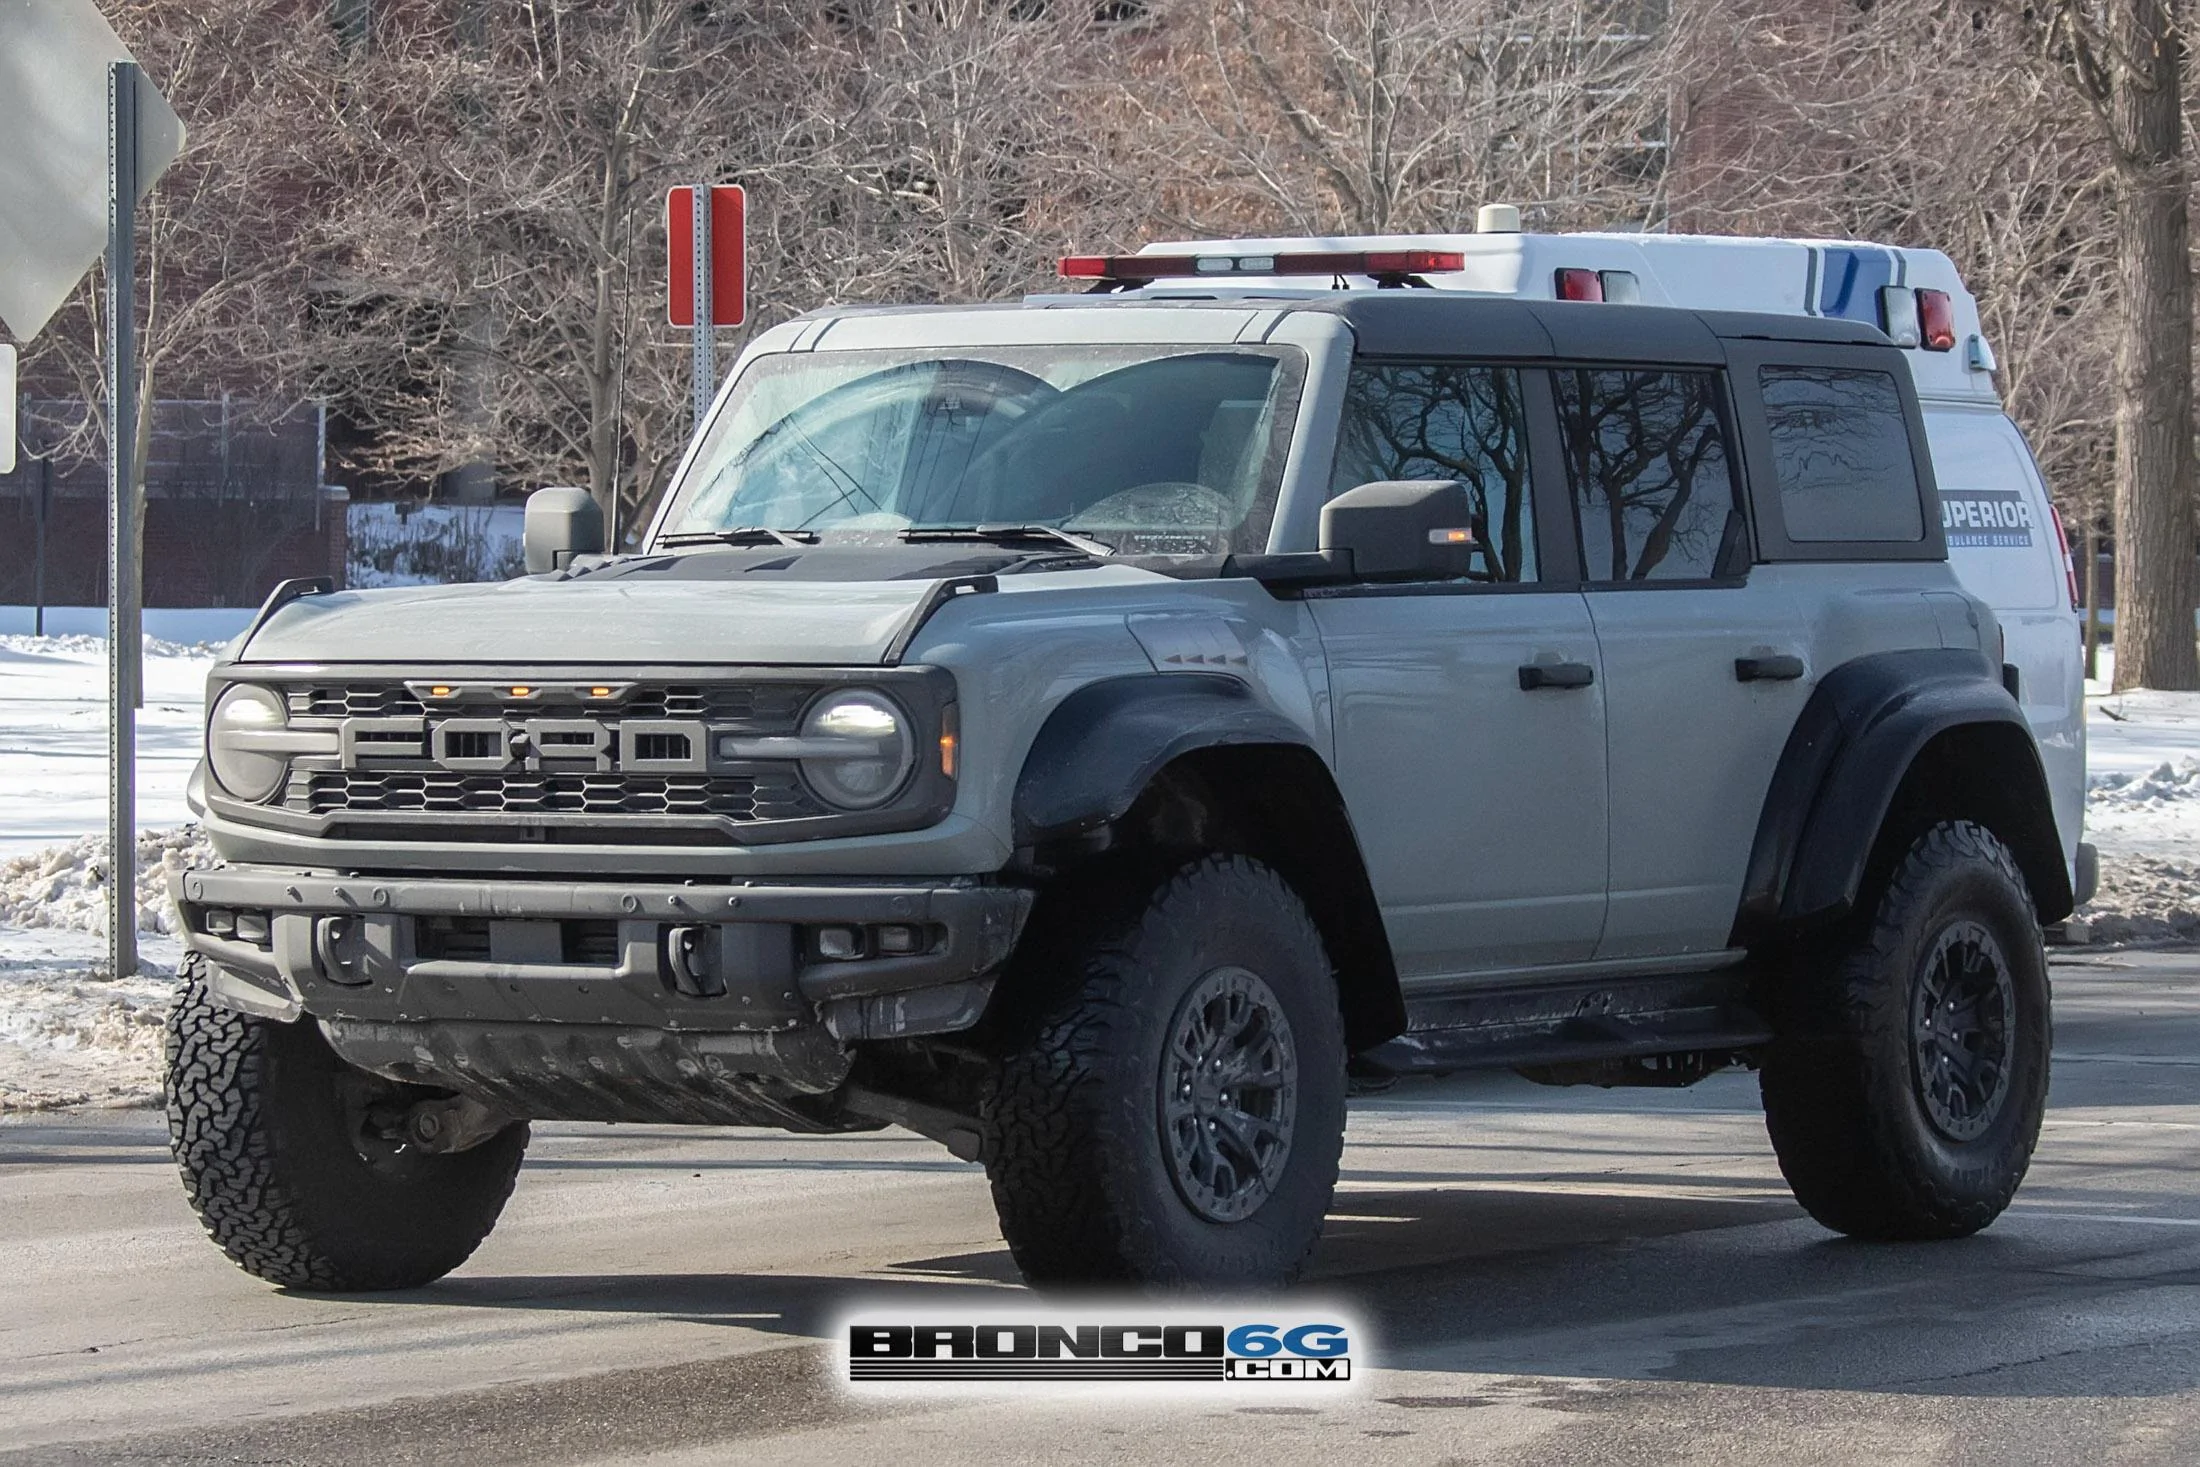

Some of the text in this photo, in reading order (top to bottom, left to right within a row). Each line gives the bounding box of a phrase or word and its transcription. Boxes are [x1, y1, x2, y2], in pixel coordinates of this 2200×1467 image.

[1942, 500, 2034, 528] UPERIOR
[1946, 535, 2029, 546] BULANCE SERVICE
[342, 718, 707, 772] FORD
